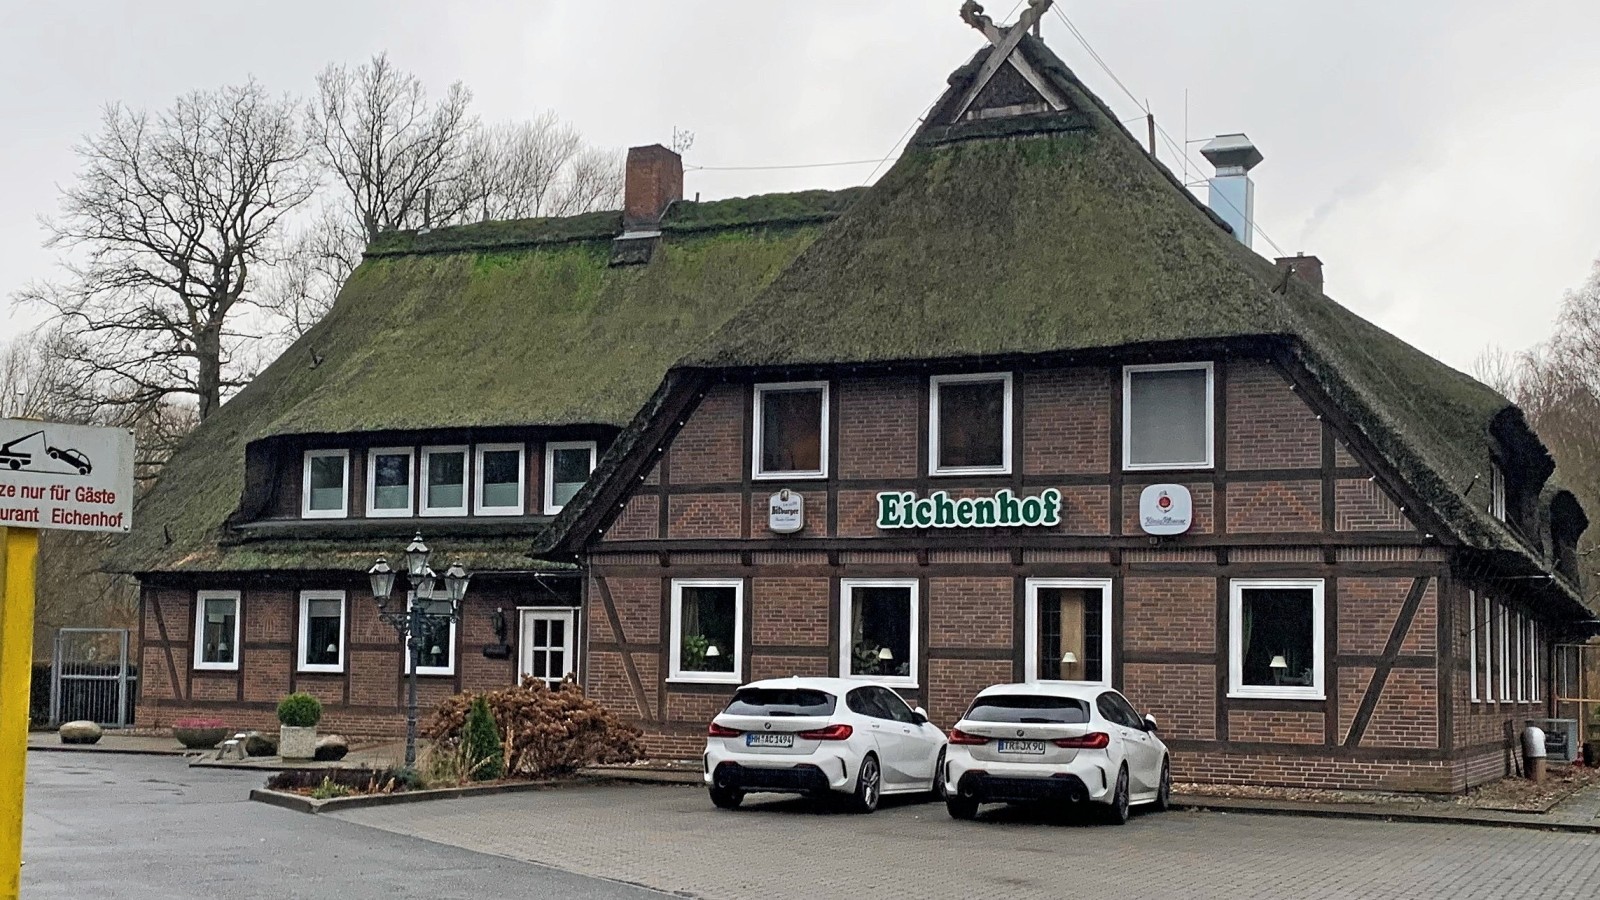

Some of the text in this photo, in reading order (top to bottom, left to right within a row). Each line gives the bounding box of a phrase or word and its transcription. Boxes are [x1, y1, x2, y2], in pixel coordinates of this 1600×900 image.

[20, 485, 45, 500] nur
[50, 485, 71, 501] für
[75, 486, 116, 504] Gäste
[51, 508, 123, 527] Eichenhof
[879, 490, 1058, 526] Eichenhof
[1004, 741, 1016, 751] TR
[1033, 741, 1043, 751] 90
